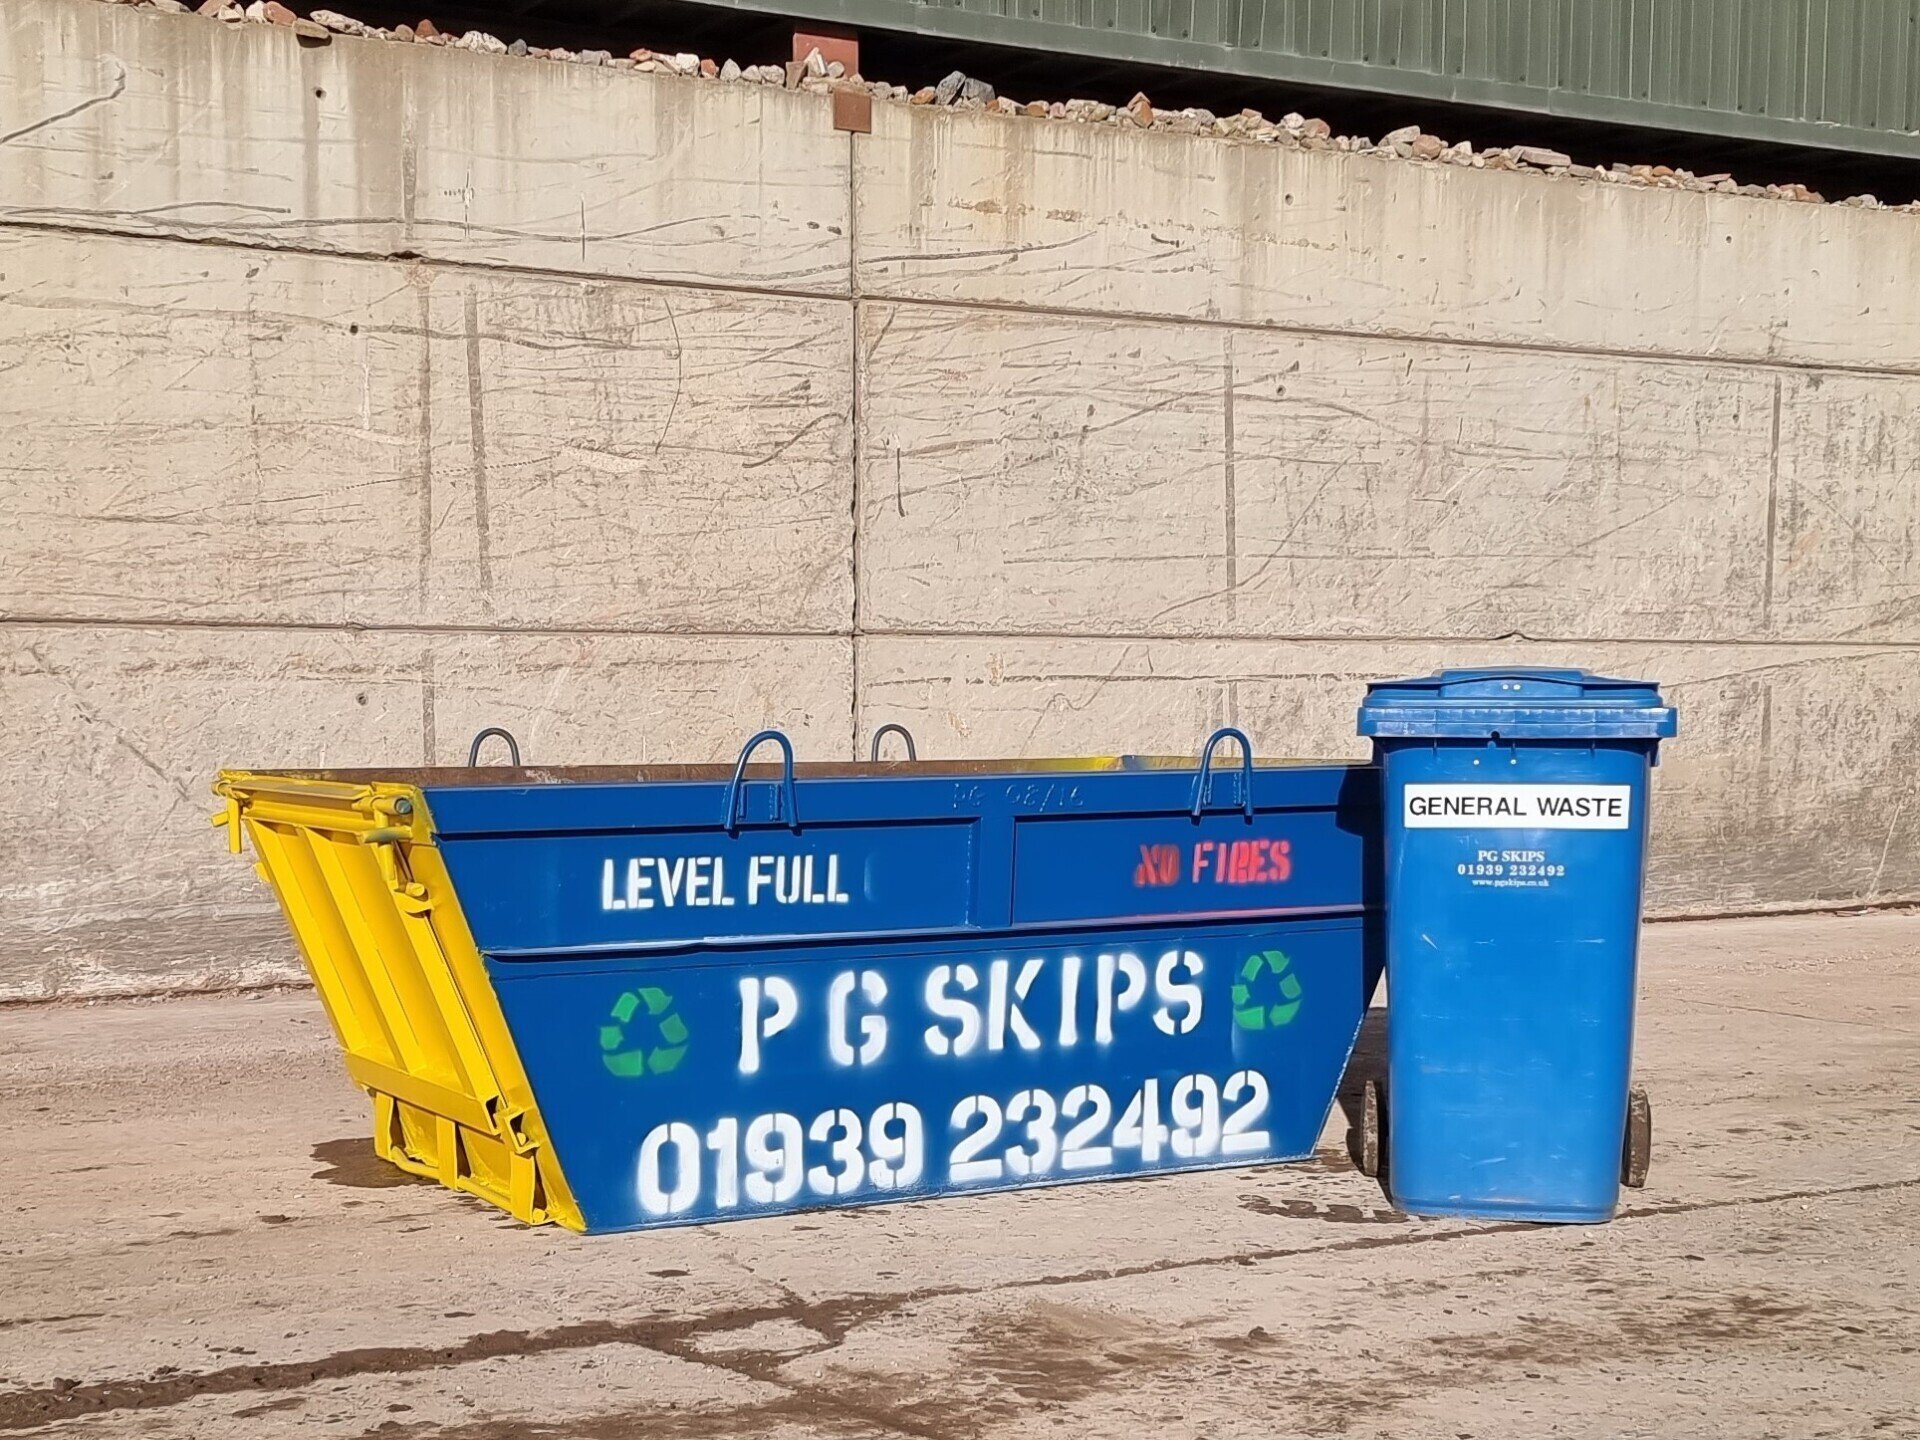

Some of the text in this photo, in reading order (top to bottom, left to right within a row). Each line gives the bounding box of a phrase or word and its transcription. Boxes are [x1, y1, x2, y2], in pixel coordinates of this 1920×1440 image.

[1409, 796, 1623, 818] GENERAL WASTE
[1192, 839, 1292, 884] FIRES
[1457, 864, 1565, 877] 01939 232492
[1478, 850, 1545, 862] PG SKIPS
[602, 854, 849, 910] LEVEL FULL
[924, 950, 1204, 1057] SKIPS
[637, 1070, 1272, 1217] 01939 232492
